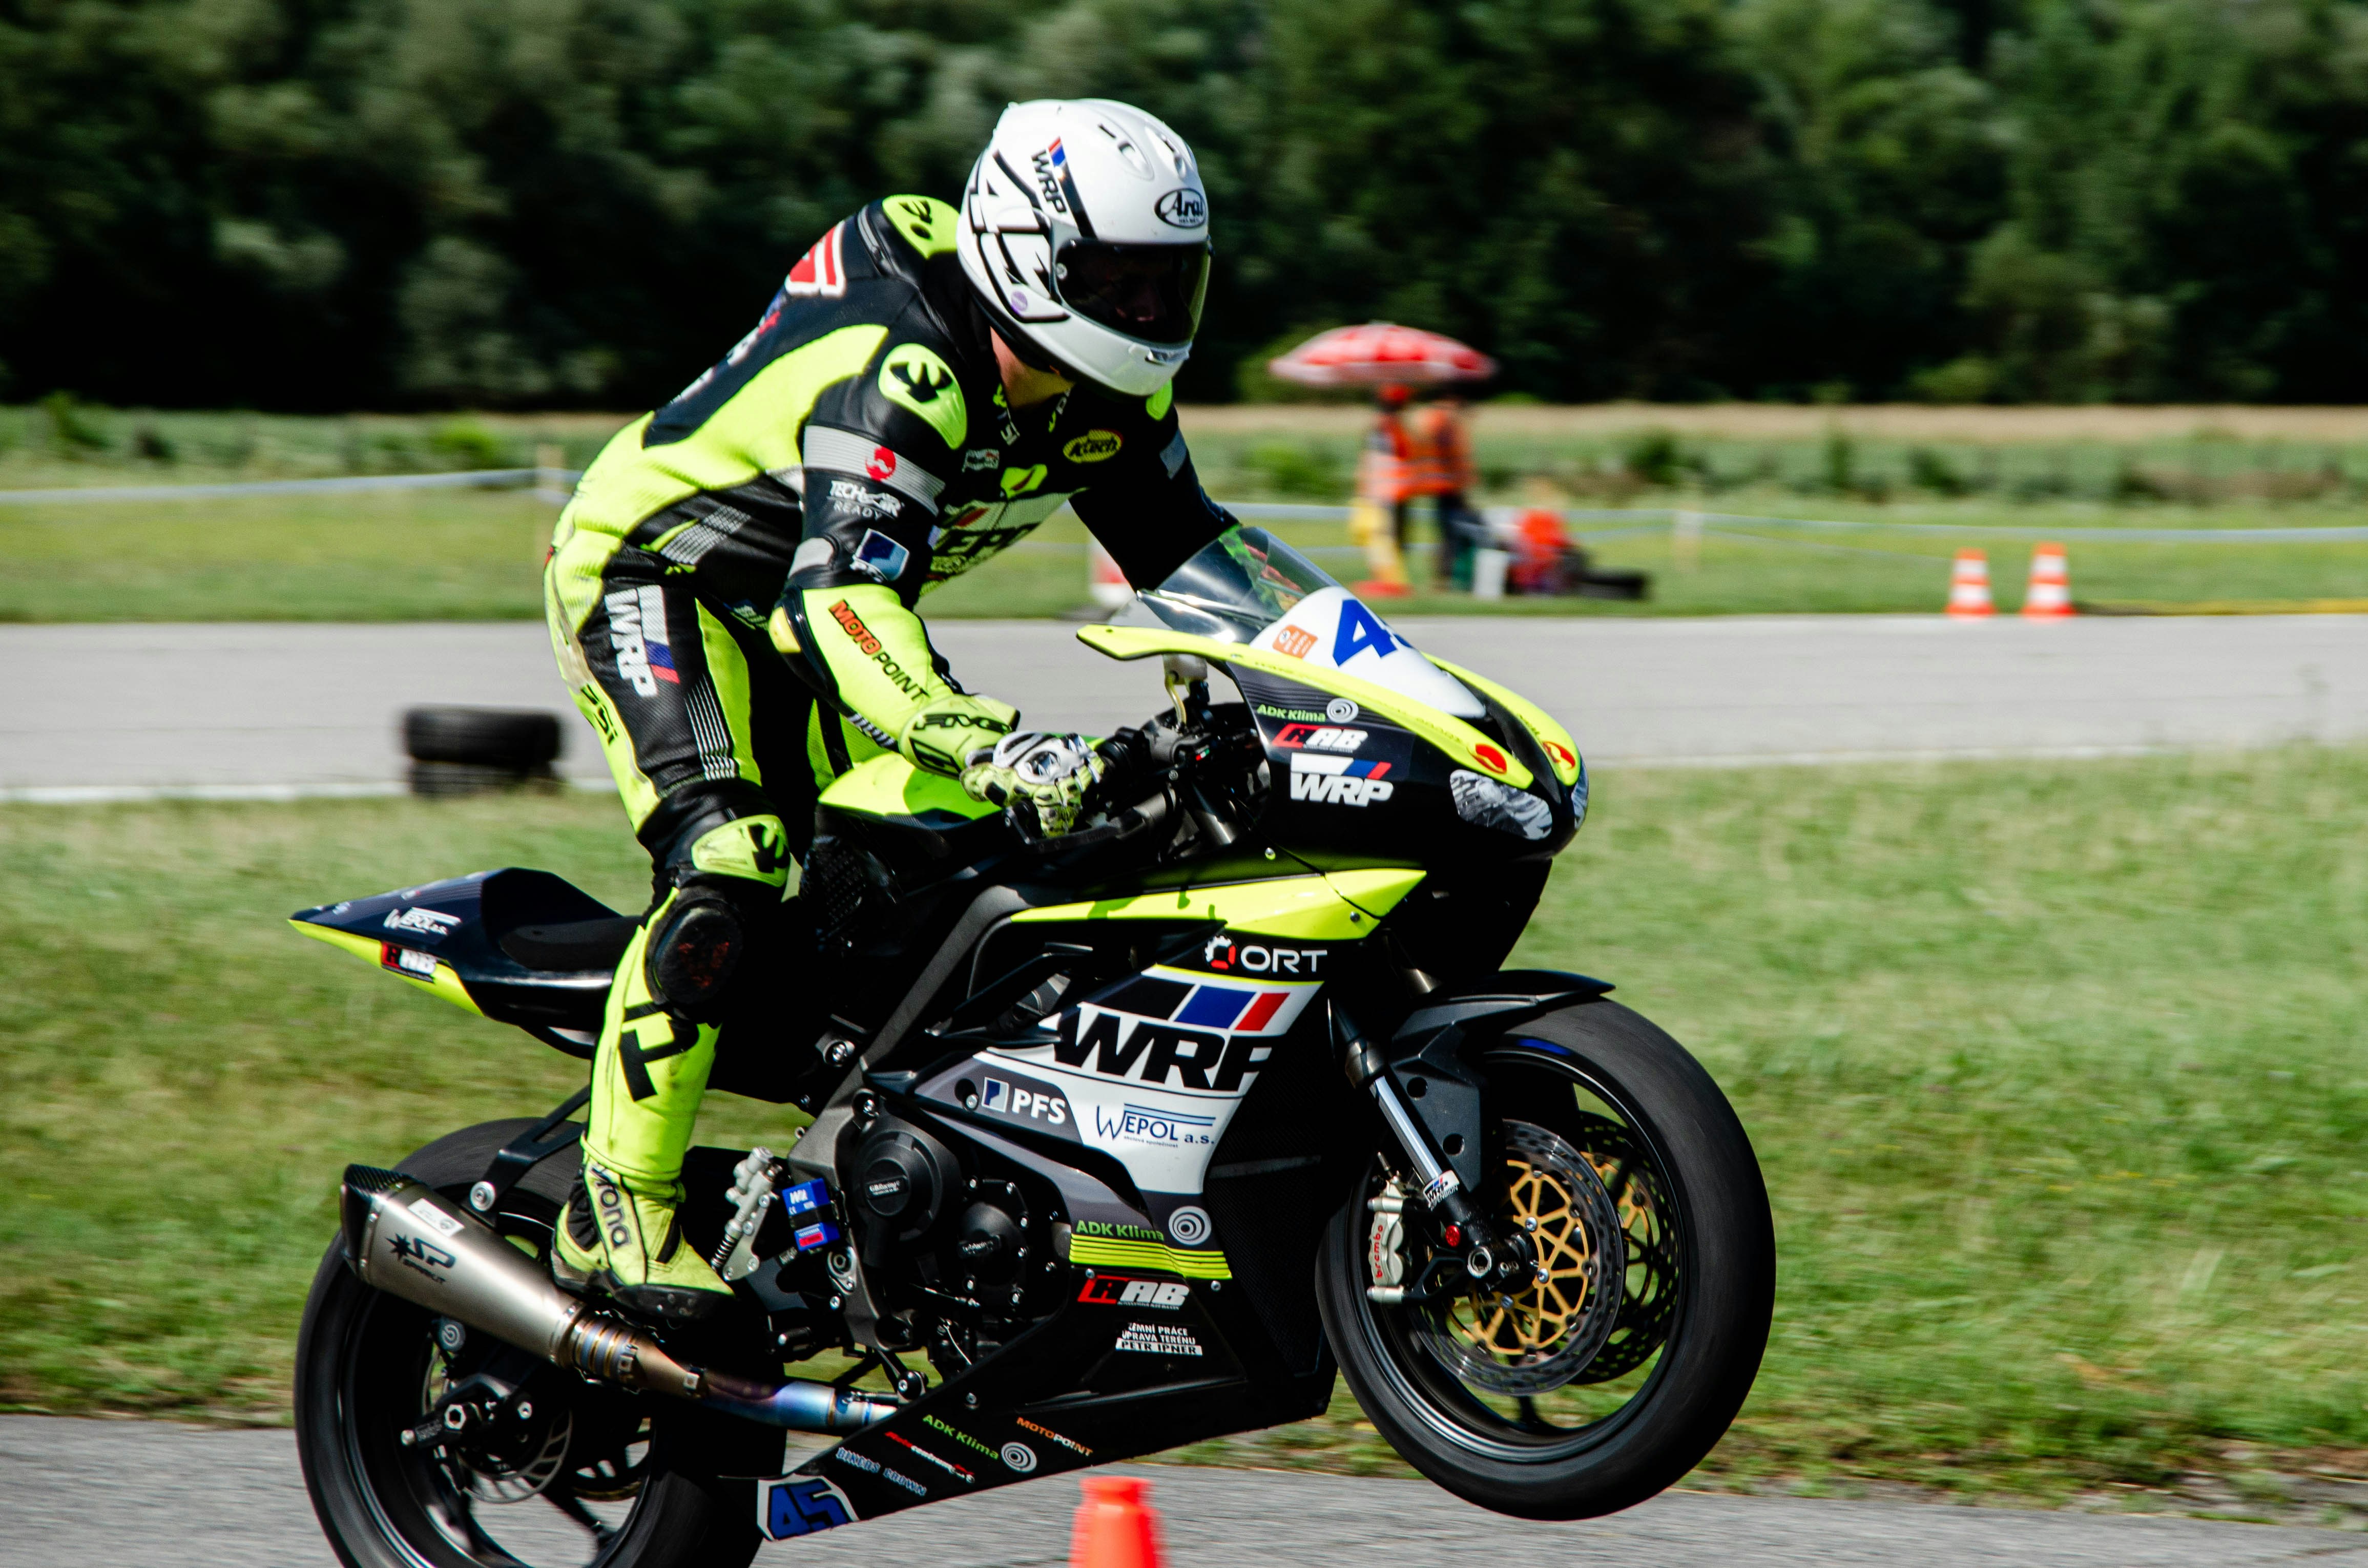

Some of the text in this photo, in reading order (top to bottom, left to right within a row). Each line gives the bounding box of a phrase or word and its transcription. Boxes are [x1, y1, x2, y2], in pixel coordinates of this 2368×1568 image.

[1031, 149, 1067, 213] WRP
[604, 588, 659, 697] WRP
[1332, 599, 1415, 667] 4
[1257, 704, 1326, 722] ADK Klima
[1291, 771, 1394, 807] WRP
[1054, 1012, 1273, 1092] WRP
[1011, 1088, 1067, 1125] PFS
[1096, 1104, 1215, 1145] WEPOL a.s.
[1076, 1220, 1165, 1242] ADK Klima
[1374, 1224, 1384, 1279] brembo
[923, 1414, 999, 1460] ADK Klima
[767, 1478, 855, 1540] 45
